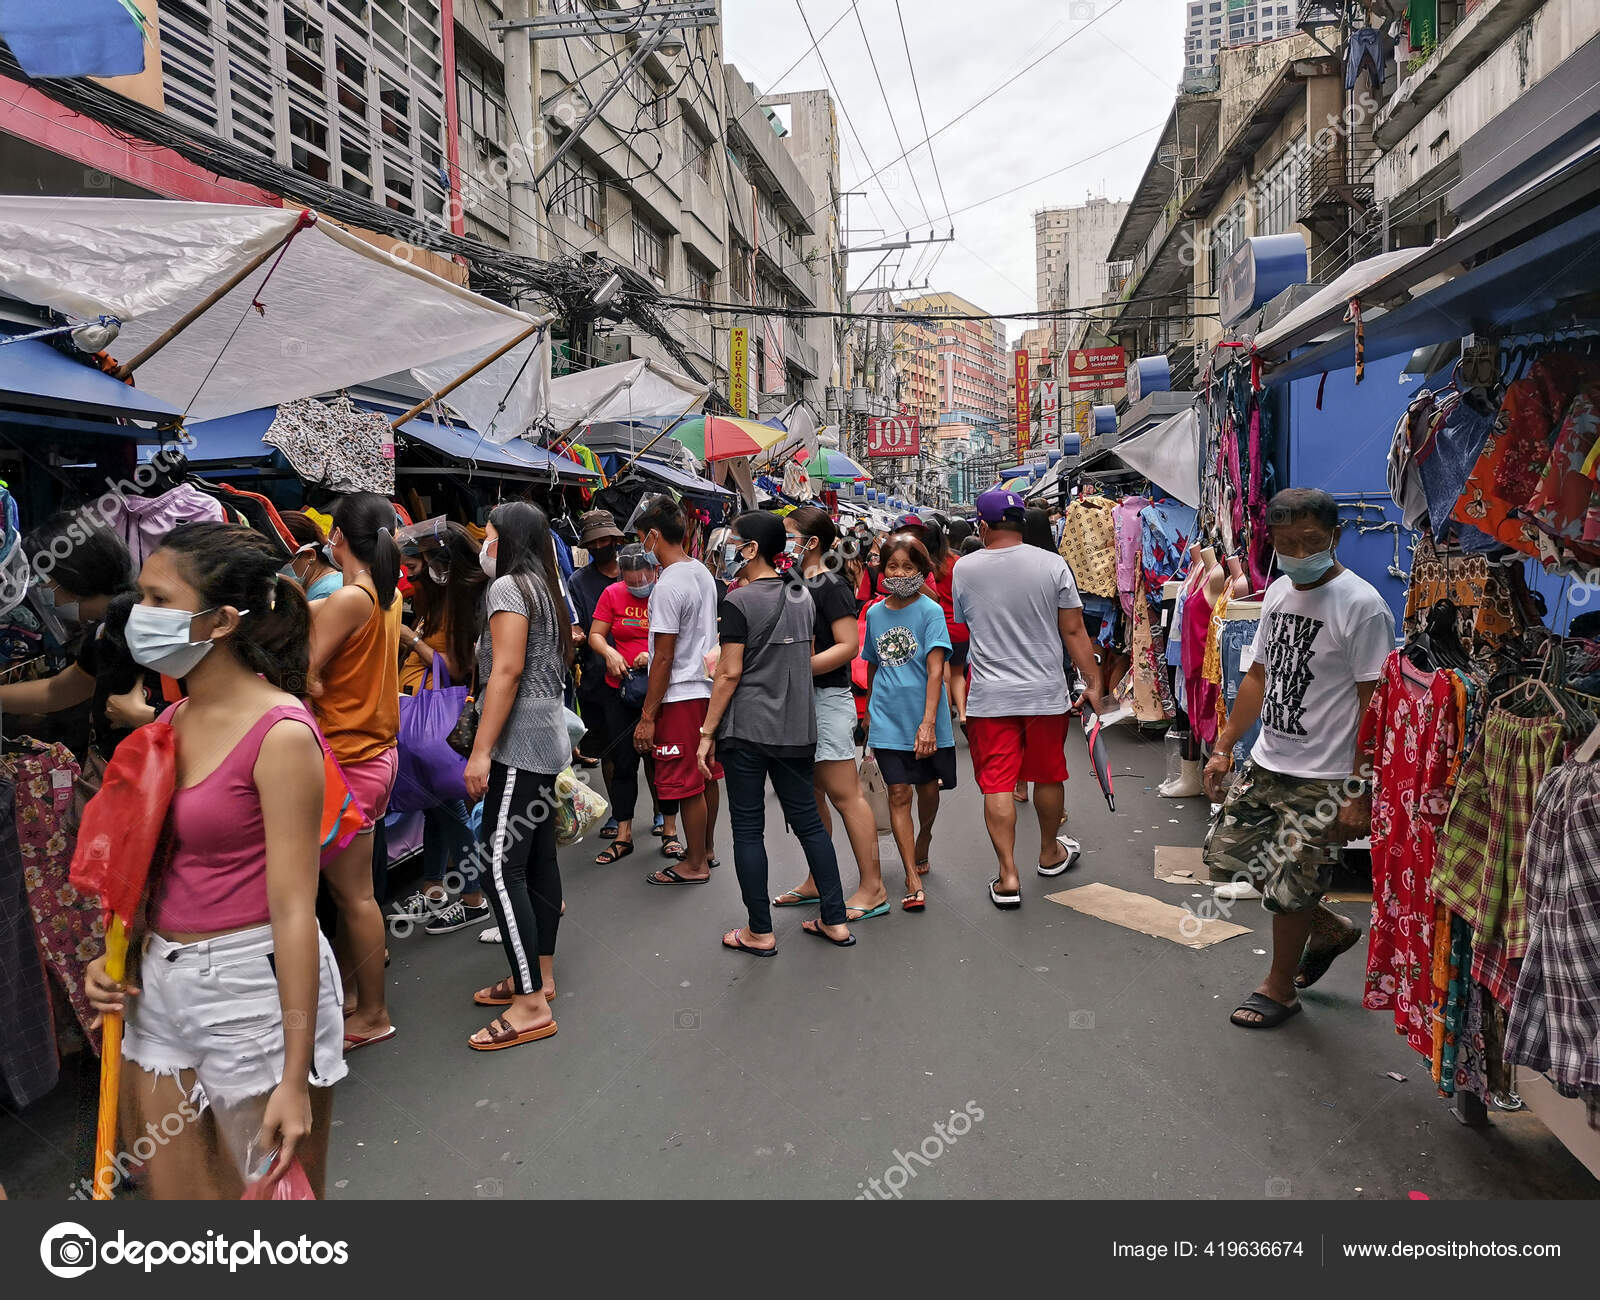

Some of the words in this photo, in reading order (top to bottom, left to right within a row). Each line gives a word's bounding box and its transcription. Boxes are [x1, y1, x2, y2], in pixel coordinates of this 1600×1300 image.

[735, 330, 743, 348] MAI
[734, 391, 742, 413] SHOP
[1017, 355, 1028, 424] DIVINE
[1044, 382, 1055, 445] YUTC
[869, 418, 917, 450] JOY
[1262, 697, 1308, 736] ORK
[656, 744, 680, 756] FILA
